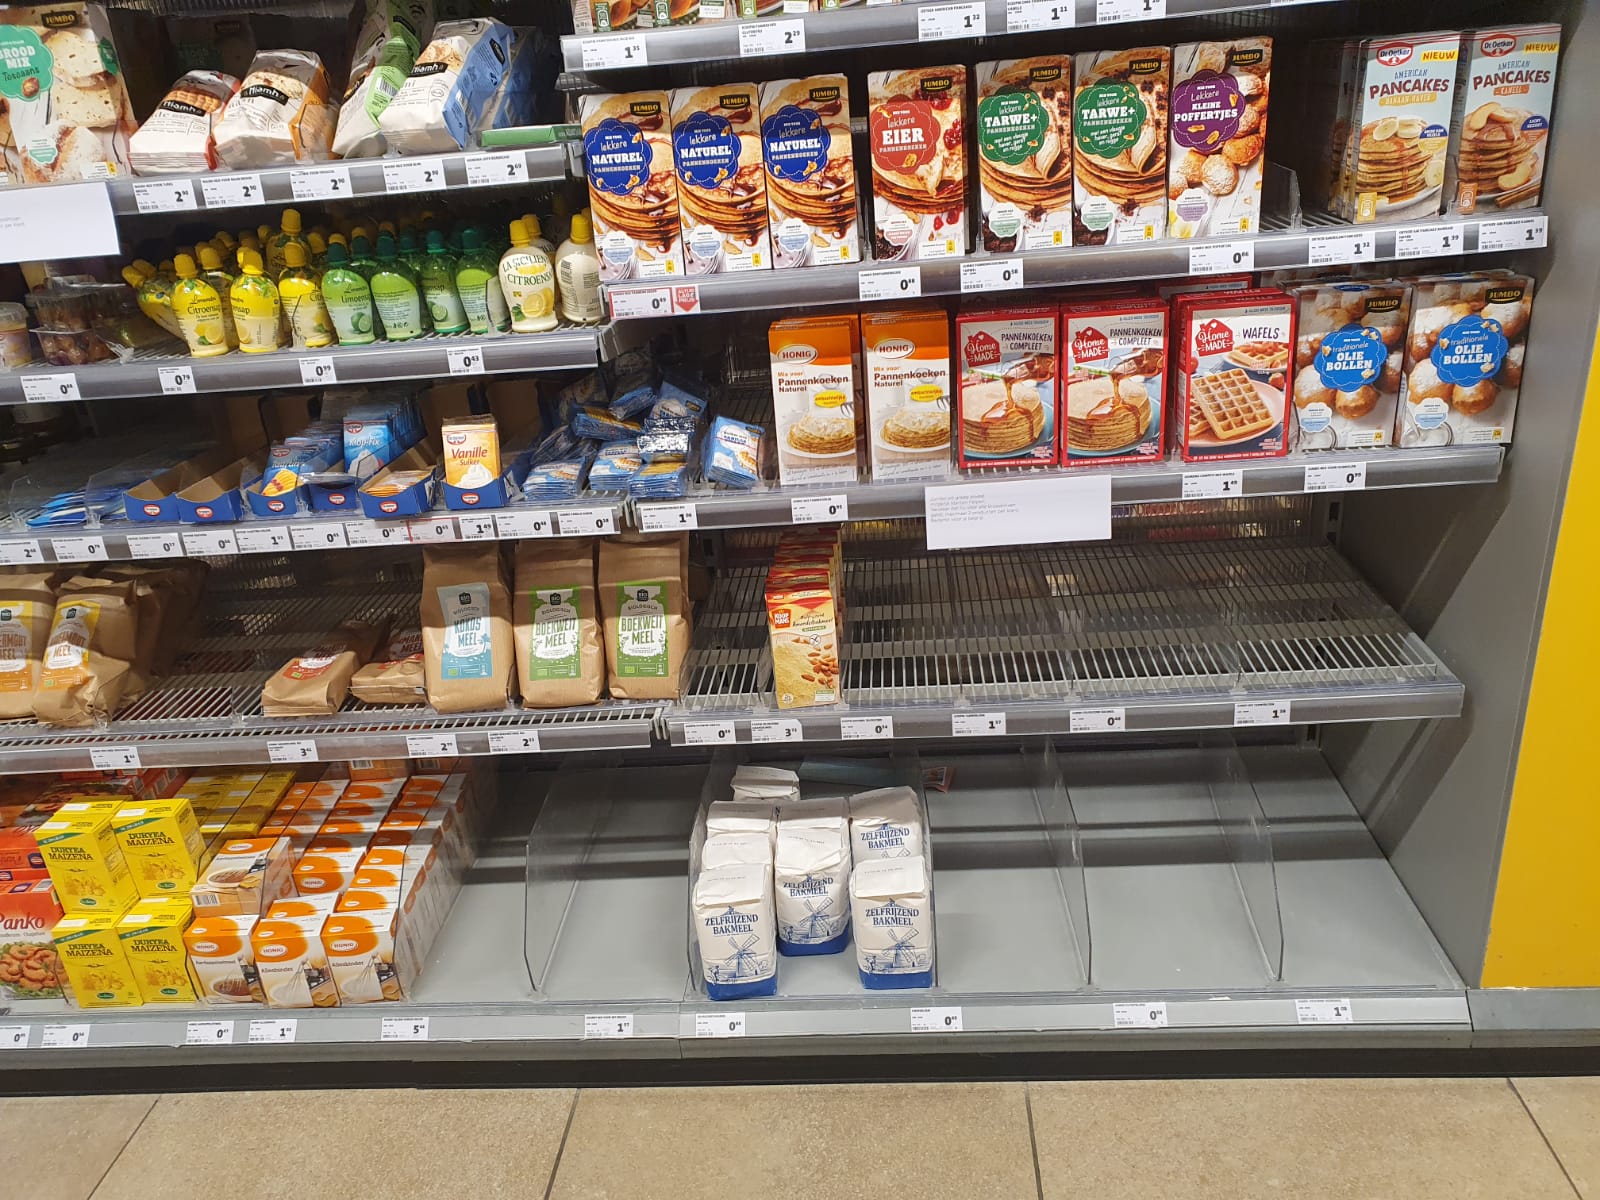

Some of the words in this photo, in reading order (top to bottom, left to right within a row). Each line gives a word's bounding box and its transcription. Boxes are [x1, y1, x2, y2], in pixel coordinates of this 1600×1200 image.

[46, 14, 75, 24] JUMBO
[1525, 43, 1558, 52] NIEUW
[1233, 52, 1260, 62] JUMBO
[1422, 51, 1456, 61] NIEUW
[6, 56, 31, 69] MIX
[1132, 61, 1159, 70] JUMBO
[1498, 60, 1531, 70] AMERICAN
[1033, 68, 1059, 78] JUMBO
[1394, 69, 1428, 80] AMERICAN
[923, 79, 950, 88] JUMBO
[1473, 70, 1551, 90] PANCAKES
[812, 89, 838, 99] JUMBO
[1369, 79, 1450, 99] PANCAKES
[722, 97, 748, 106] JUMBO
[1191, 101, 1221, 111] KLEINE
[633, 104, 659, 112] JUMBO
[1081, 105, 1136, 120] TARWE+
[984, 113, 1038, 128] TARWE+
[1174, 108, 1238, 123] POFFERTJES
[882, 127, 924, 145] EIER
[770, 138, 821, 152] NATUREL
[680, 145, 732, 158] NATUREL
[591, 152, 643, 165] NATUREL
[1489, 289, 1521, 299] JUMBO
[1368, 299, 1398, 308] JUMBO
[1001, 333, 1053, 342] PANNENKOEKEN
[1110, 328, 1163, 338] PANNENKOEKEN
[1199, 329, 1230, 342] Home
[1242, 327, 1280, 340] WAFELS
[968, 341, 997, 353] Home
[1009, 342, 1042, 350] COMPLEET
[1075, 337, 1105, 350] Home
[1118, 337, 1152, 346] COMPLEET
[1205, 340, 1227, 351] MADE
[879, 344, 909, 353] HONIG
[1081, 347, 1102, 358] MADE
[1454, 344, 1484, 355] OLIE
[782, 350, 812, 359] HONIG
[974, 352, 995, 363] MADE
[1336, 351, 1364, 361] OLIE
[1443, 353, 1493, 365] BOLLEN
[1326, 360, 1372, 371] BOLLEN
[874, 369, 946, 381] Pannenkoeken
[778, 376, 849, 387] Pannenkoeken
[874, 380, 903, 388] Naturel
[778, 385, 807, 393] Naturel
[452, 446, 488, 460] Vanille
[459, 458, 480, 466] Suiker
[454, 618, 481, 632] KOKOS
[536, 618, 576, 635] BOEKWEIT
[621, 616, 663, 632] BOEKWEIT
[457, 632, 477, 647] MEEL
[545, 631, 567, 646] MEEL
[631, 630, 655, 645] MEEL
[861, 826, 910, 841] ZELFRIJZEND
[126, 837, 176, 847] MAIZENA
[868, 837, 905, 849] BAKMEEL
[48, 852, 94, 861] MAIZENA
[790, 886, 829, 897] BAKMEEL
[865, 907, 919, 920] ZELFRIJZEND
[704, 913, 759, 927] ZELFRIJZEND
[872, 916, 914, 927] BAKMEEL
[713, 923, 753, 935] BAKMEEL
[65, 948, 113, 957] MAIZENA
[131, 943, 178, 953] MAIZENA
